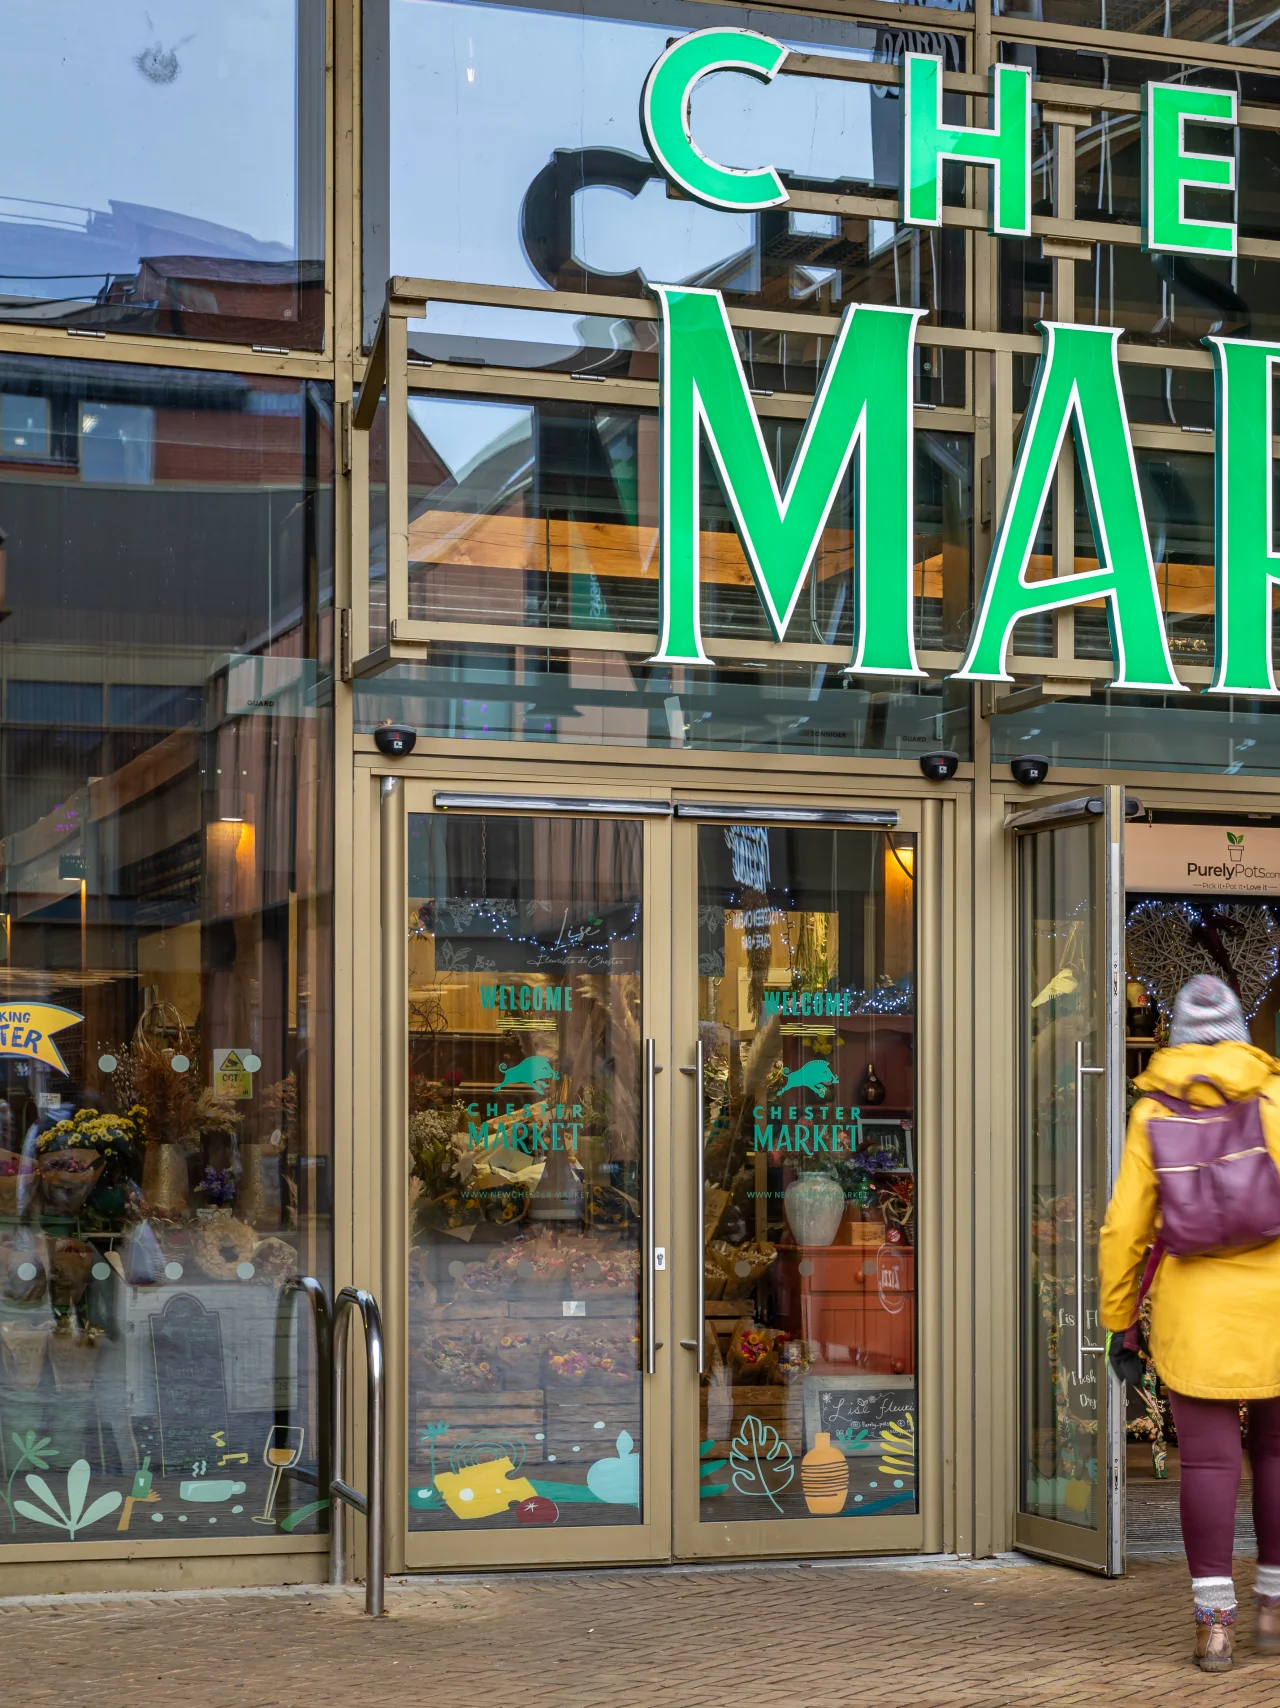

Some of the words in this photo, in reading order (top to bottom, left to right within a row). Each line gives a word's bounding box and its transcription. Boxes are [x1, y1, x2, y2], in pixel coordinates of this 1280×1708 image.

[902, 735, 927, 743] GUARD
[554, 907, 601, 951] Lise
[587, 954, 627, 968] Chester
[480, 985, 573, 1012] WELCOME
[764, 991, 851, 1017] WELCOME
[467, 1102, 584, 1118] CHESTER
[752, 1105, 861, 1120] CHESTER
[467, 1121, 584, 1155] MARKET
[753, 1124, 862, 1156] MARKET
[829, 1397, 871, 1422] Lise
